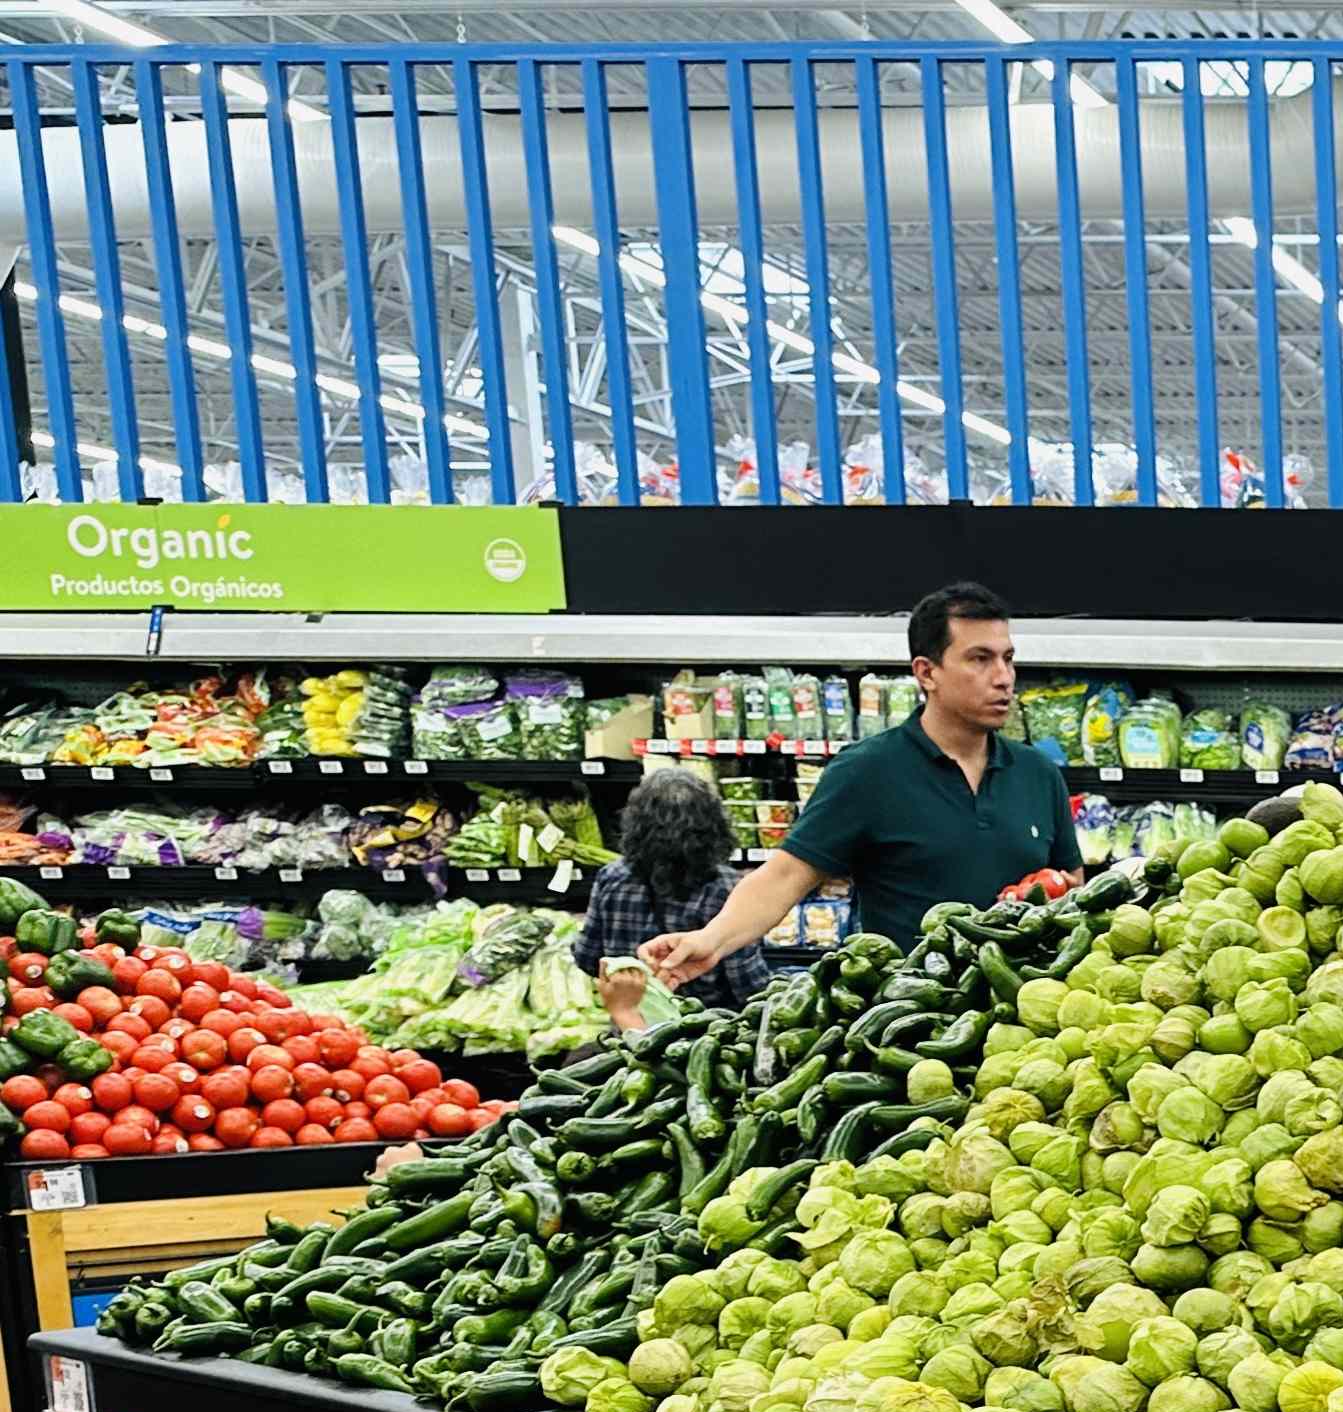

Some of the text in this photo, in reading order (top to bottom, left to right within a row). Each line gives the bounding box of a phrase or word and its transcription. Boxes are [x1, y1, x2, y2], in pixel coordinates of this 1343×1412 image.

[67, 513, 255, 569] Organic
[50, 573, 284, 604] Productos Orgánicos
